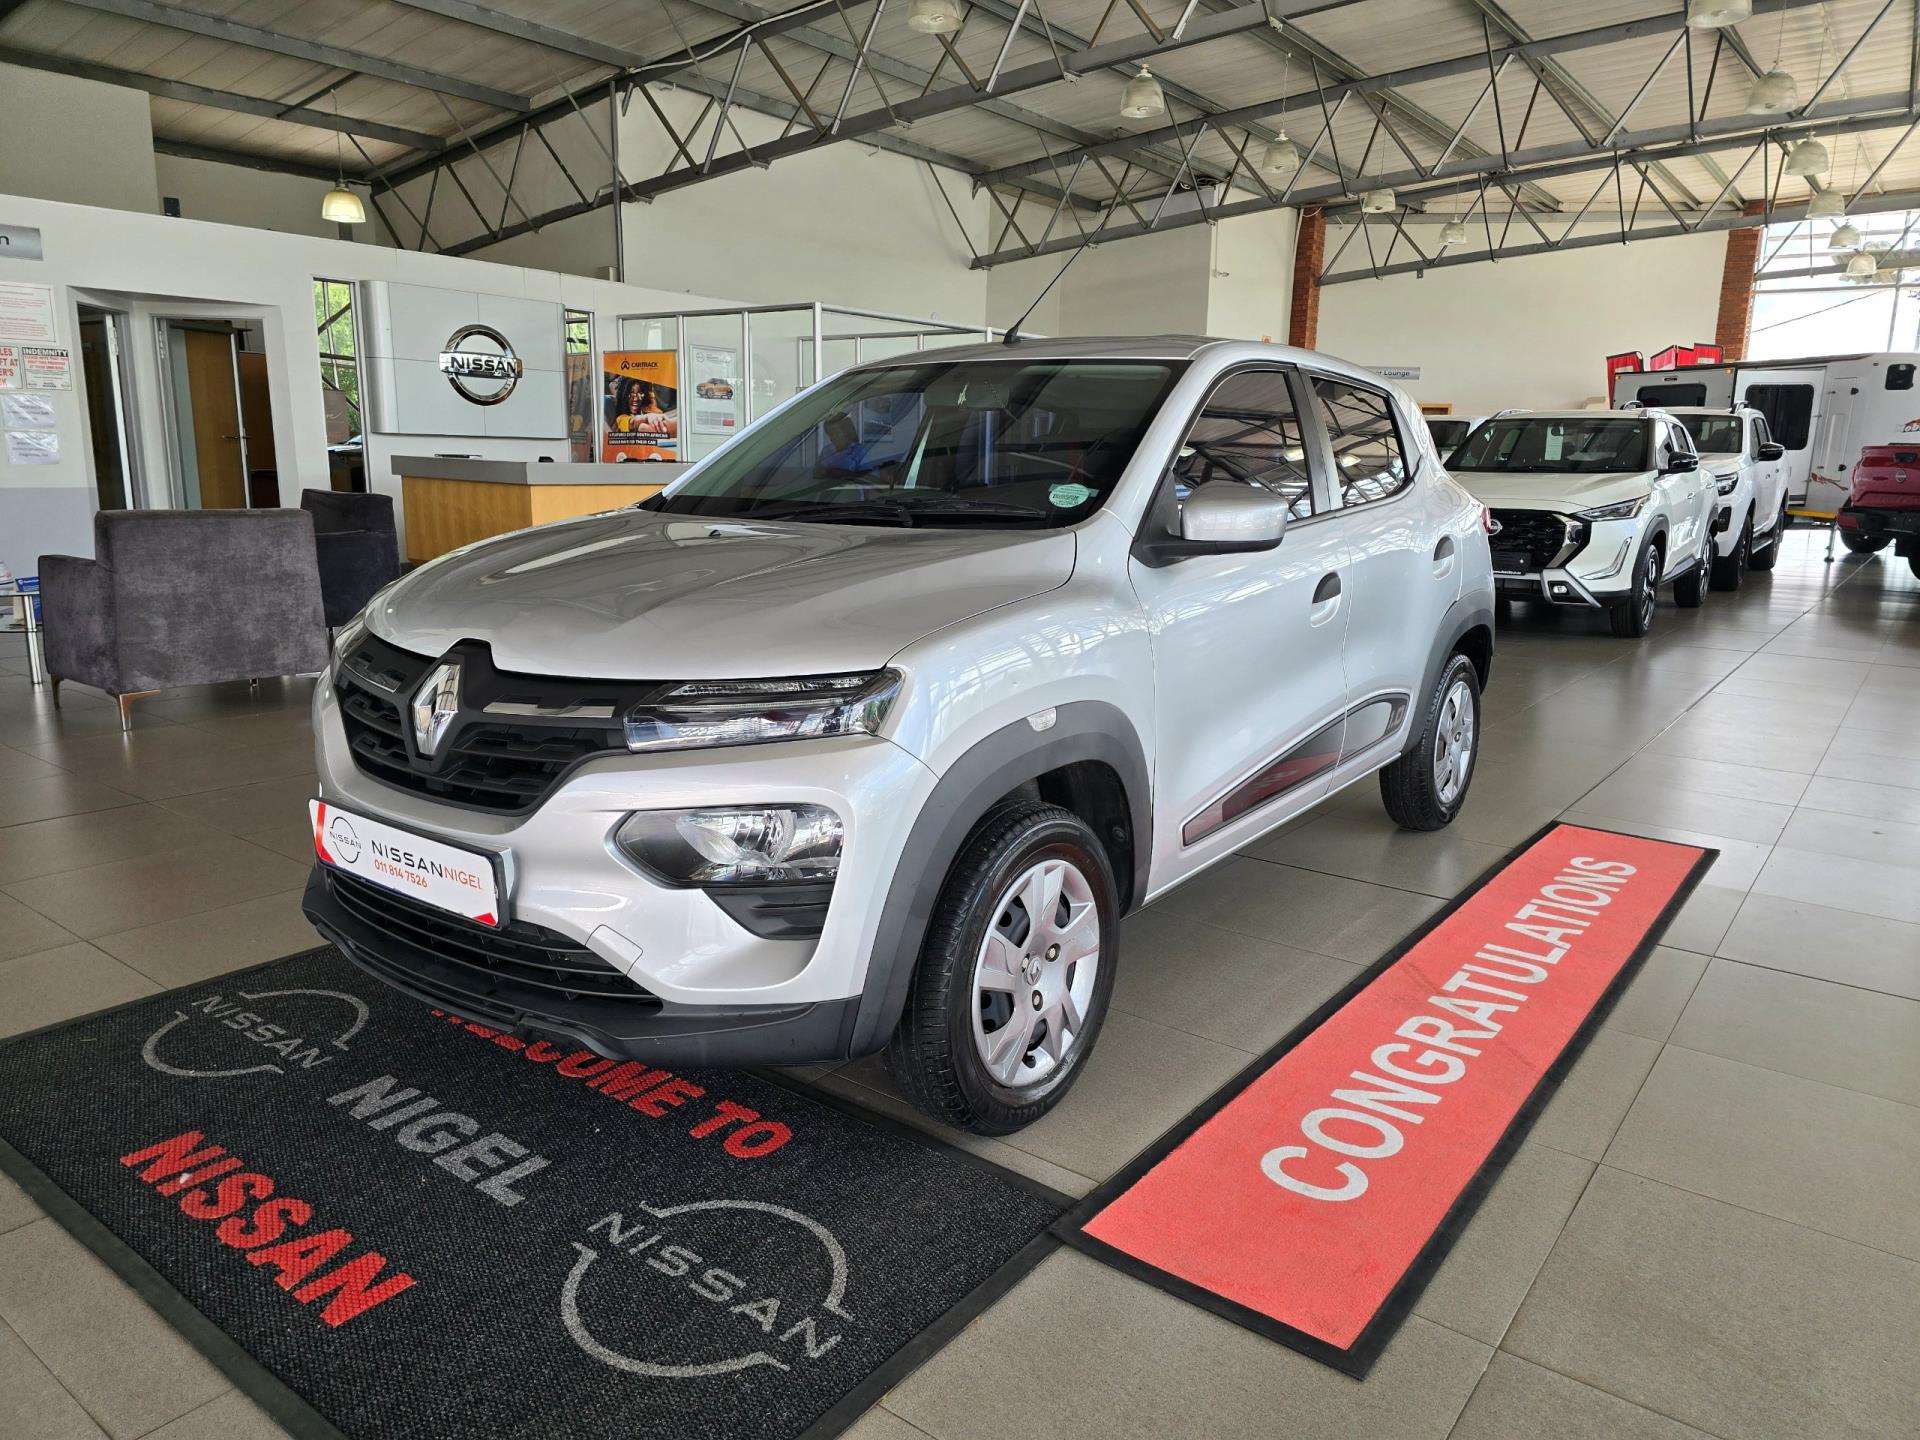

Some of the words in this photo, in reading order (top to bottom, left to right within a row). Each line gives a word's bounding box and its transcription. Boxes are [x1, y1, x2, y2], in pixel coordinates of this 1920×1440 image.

[22, 347, 68, 357] INDEMNITY
[450, 356, 517, 377] NISSAN
[1384, 369, 1410, 378] Lounge
[330, 831, 362, 850] NISSAN
[374, 859, 388, 873] 011
[389, 864, 404, 879] 814
[404, 870, 428, 888] 7526
[191, 995, 333, 1069] NISSAN
[1260, 856, 1638, 1202] CONGRATULATIONS
[326, 1074, 551, 1207] NIGEL
[688, 1100, 793, 1159] TO
[119, 1130, 418, 1328] NISSAN
[587, 1211, 843, 1359] NISSAN
